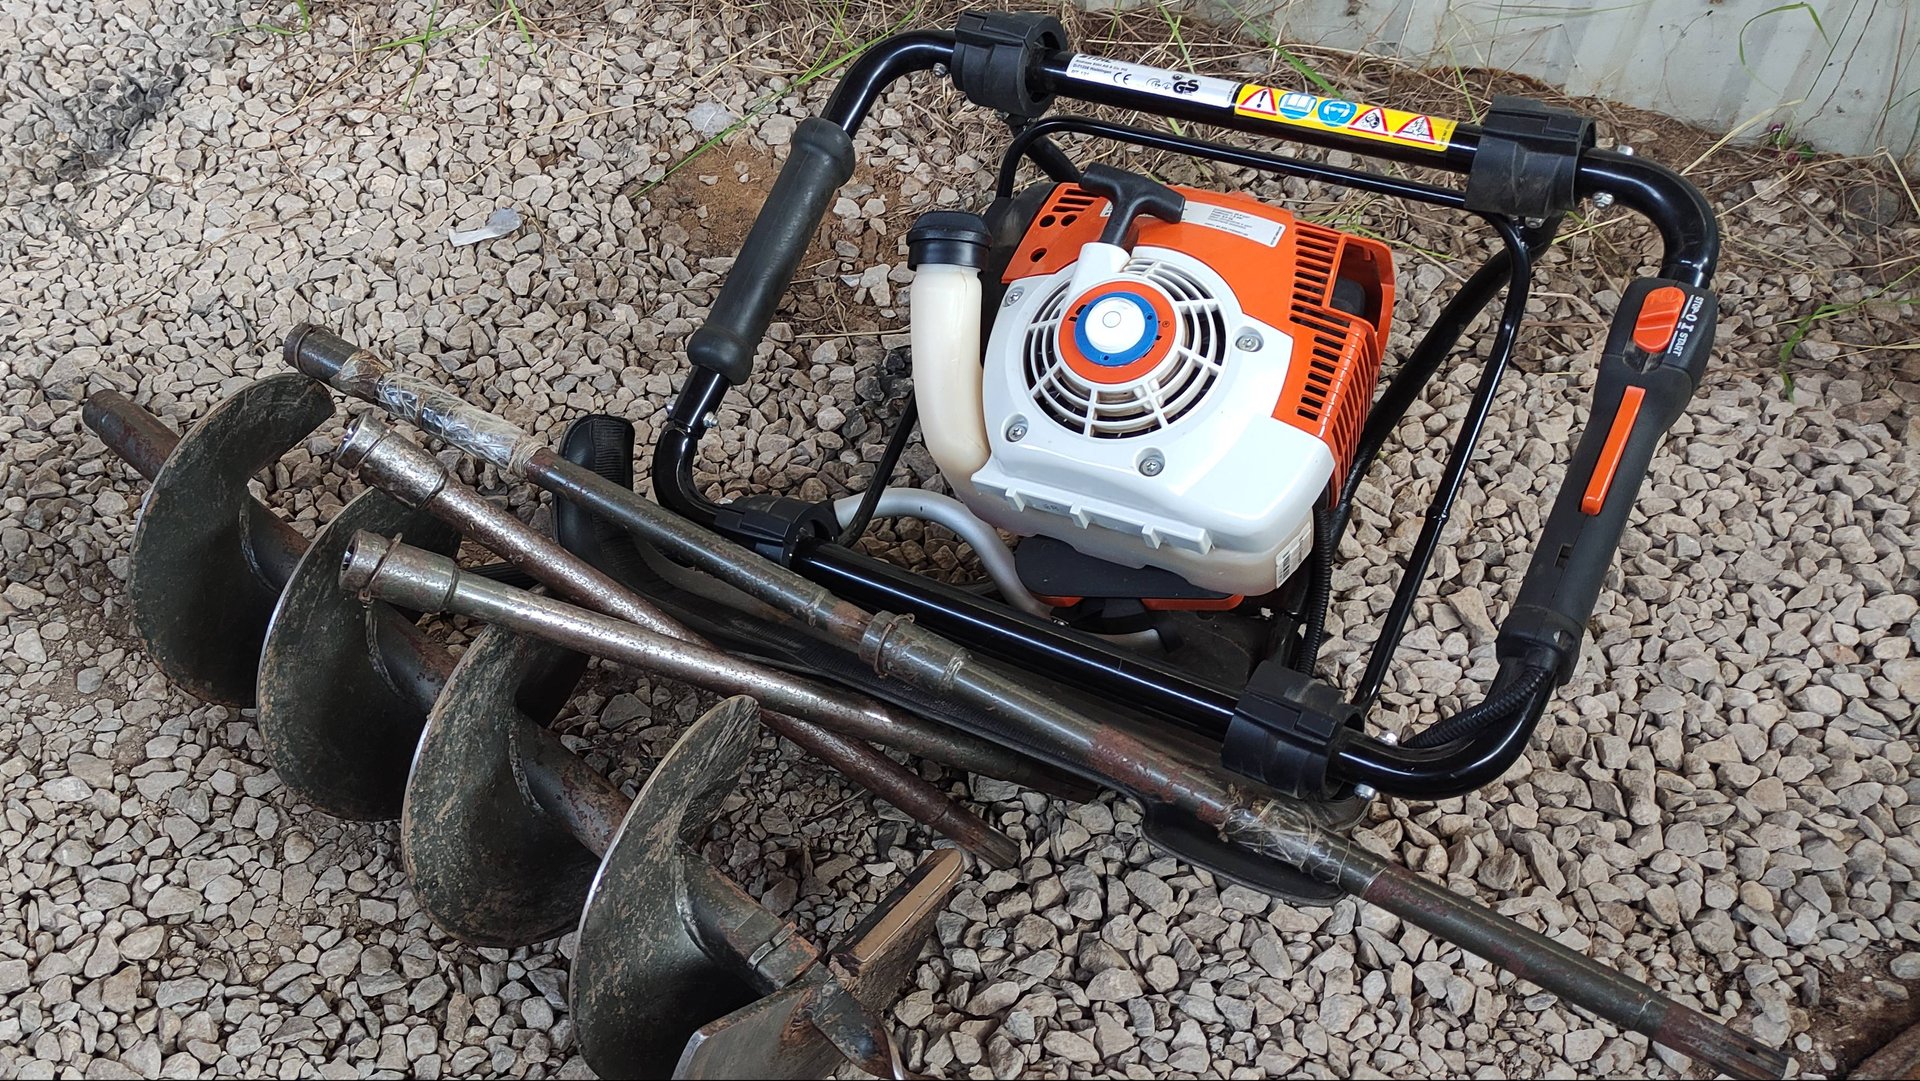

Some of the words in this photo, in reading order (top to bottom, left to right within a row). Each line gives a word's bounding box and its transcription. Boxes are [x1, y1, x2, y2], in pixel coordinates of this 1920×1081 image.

[1113, 72, 1132, 86] CE
[1173, 80, 1199, 94] GS
[1672, 332, 1689, 357] START
